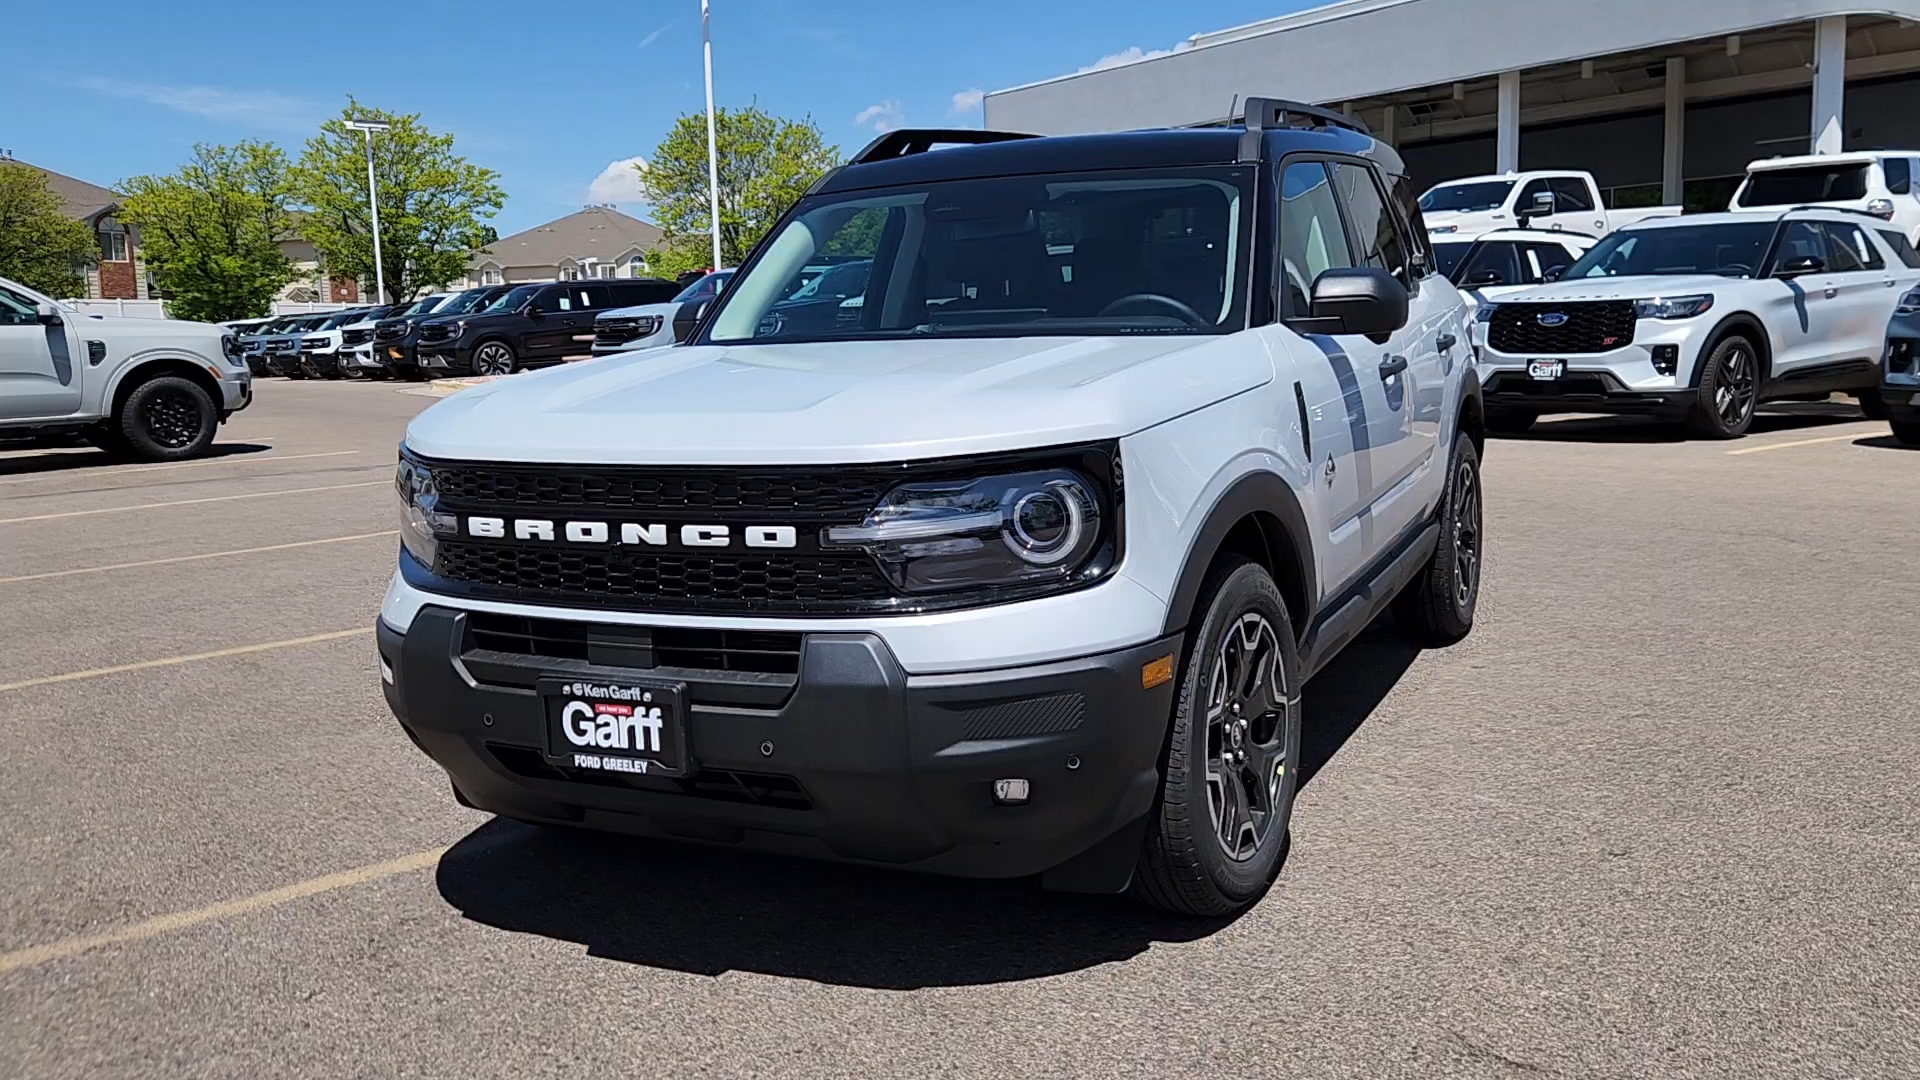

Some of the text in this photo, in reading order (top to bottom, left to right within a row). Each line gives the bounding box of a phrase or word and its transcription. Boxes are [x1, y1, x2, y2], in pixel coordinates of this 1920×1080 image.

[1529, 362, 1563, 377] Garff
[468, 516, 796, 548] BRONCO
[562, 701, 663, 752] Garff
[574, 754, 648, 773] FORD GREELEY
